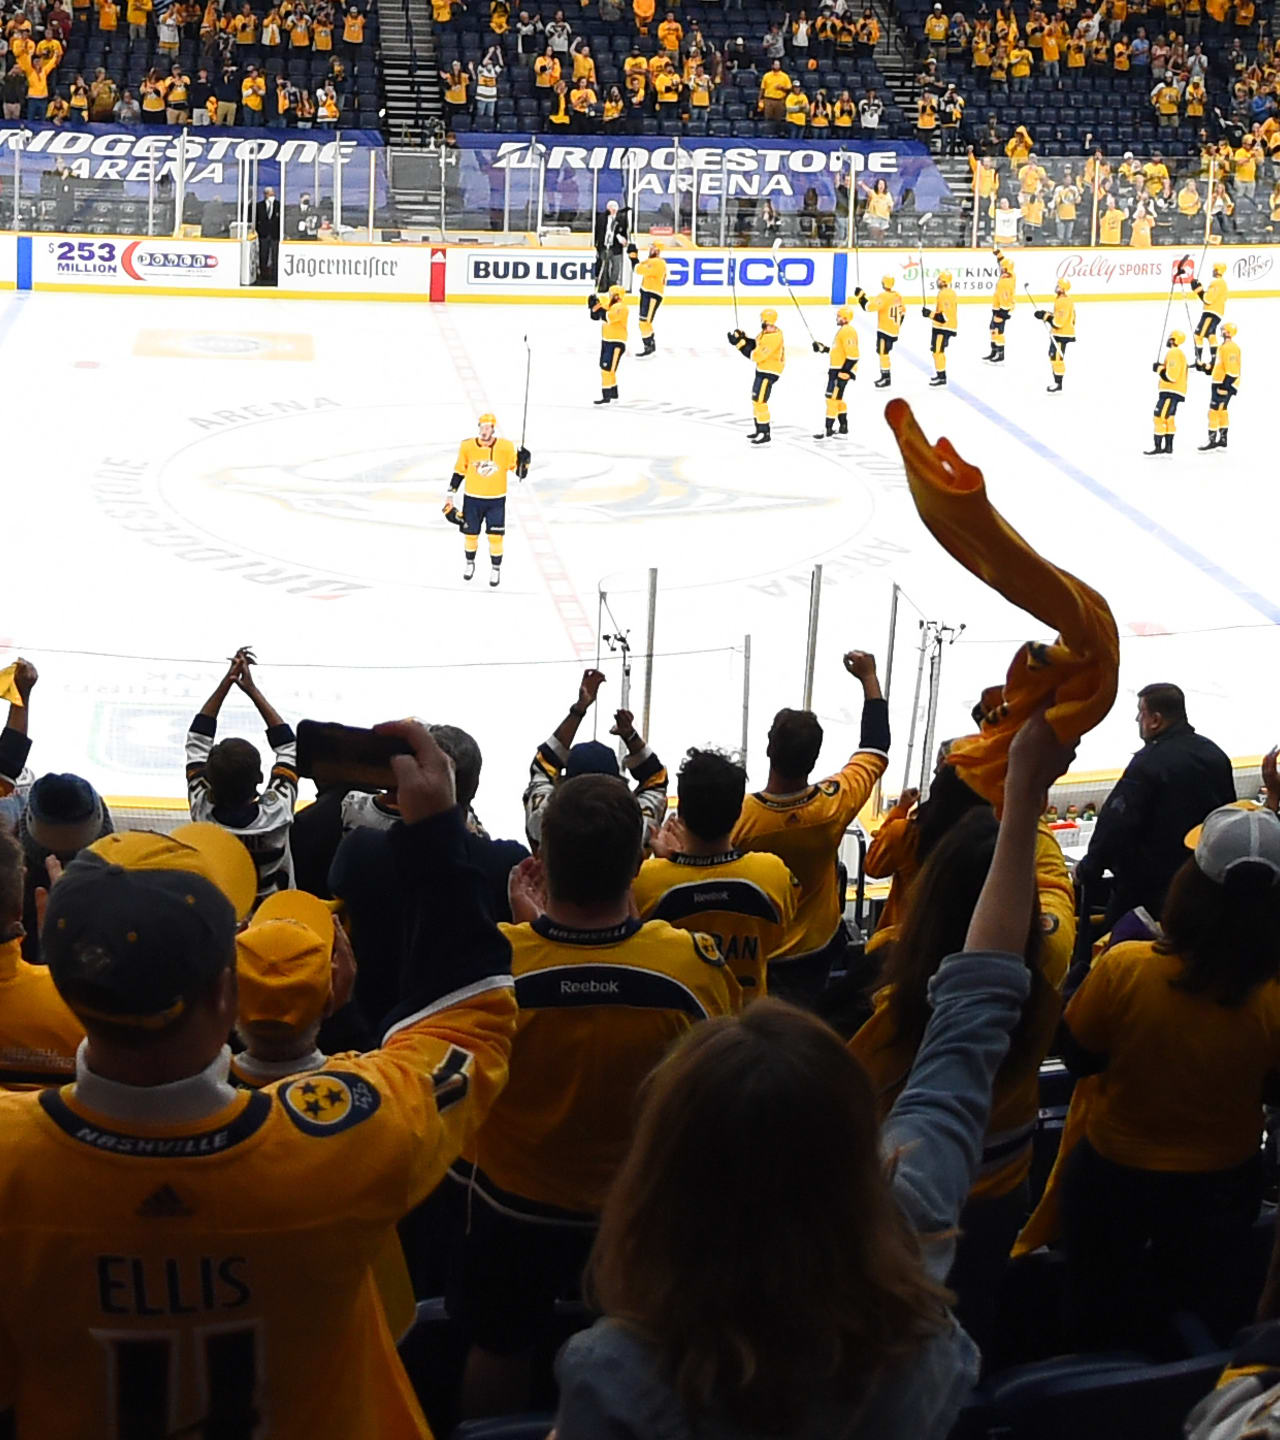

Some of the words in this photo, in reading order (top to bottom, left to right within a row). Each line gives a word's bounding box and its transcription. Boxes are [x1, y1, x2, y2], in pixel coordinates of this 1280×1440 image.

[70, 159, 225, 184] ARENA
[492, 142, 898, 173] BRIDGESTONE
[633, 173, 794, 196] ARENA
[57, 261, 118, 274] MILLION
[472, 259, 532, 281] BUD
[535, 260, 597, 281] LIGH
[665, 257, 815, 287] GEICO
[1056, 254, 1117, 284] Bally
[1118, 261, 1162, 277] SPORTS
[188, 396, 344, 430] ARENA
[560, 979, 620, 994] Reebok
[75, 1125, 229, 1154] NASHVILLE
[96, 1255, 251, 1315] ELLIS
